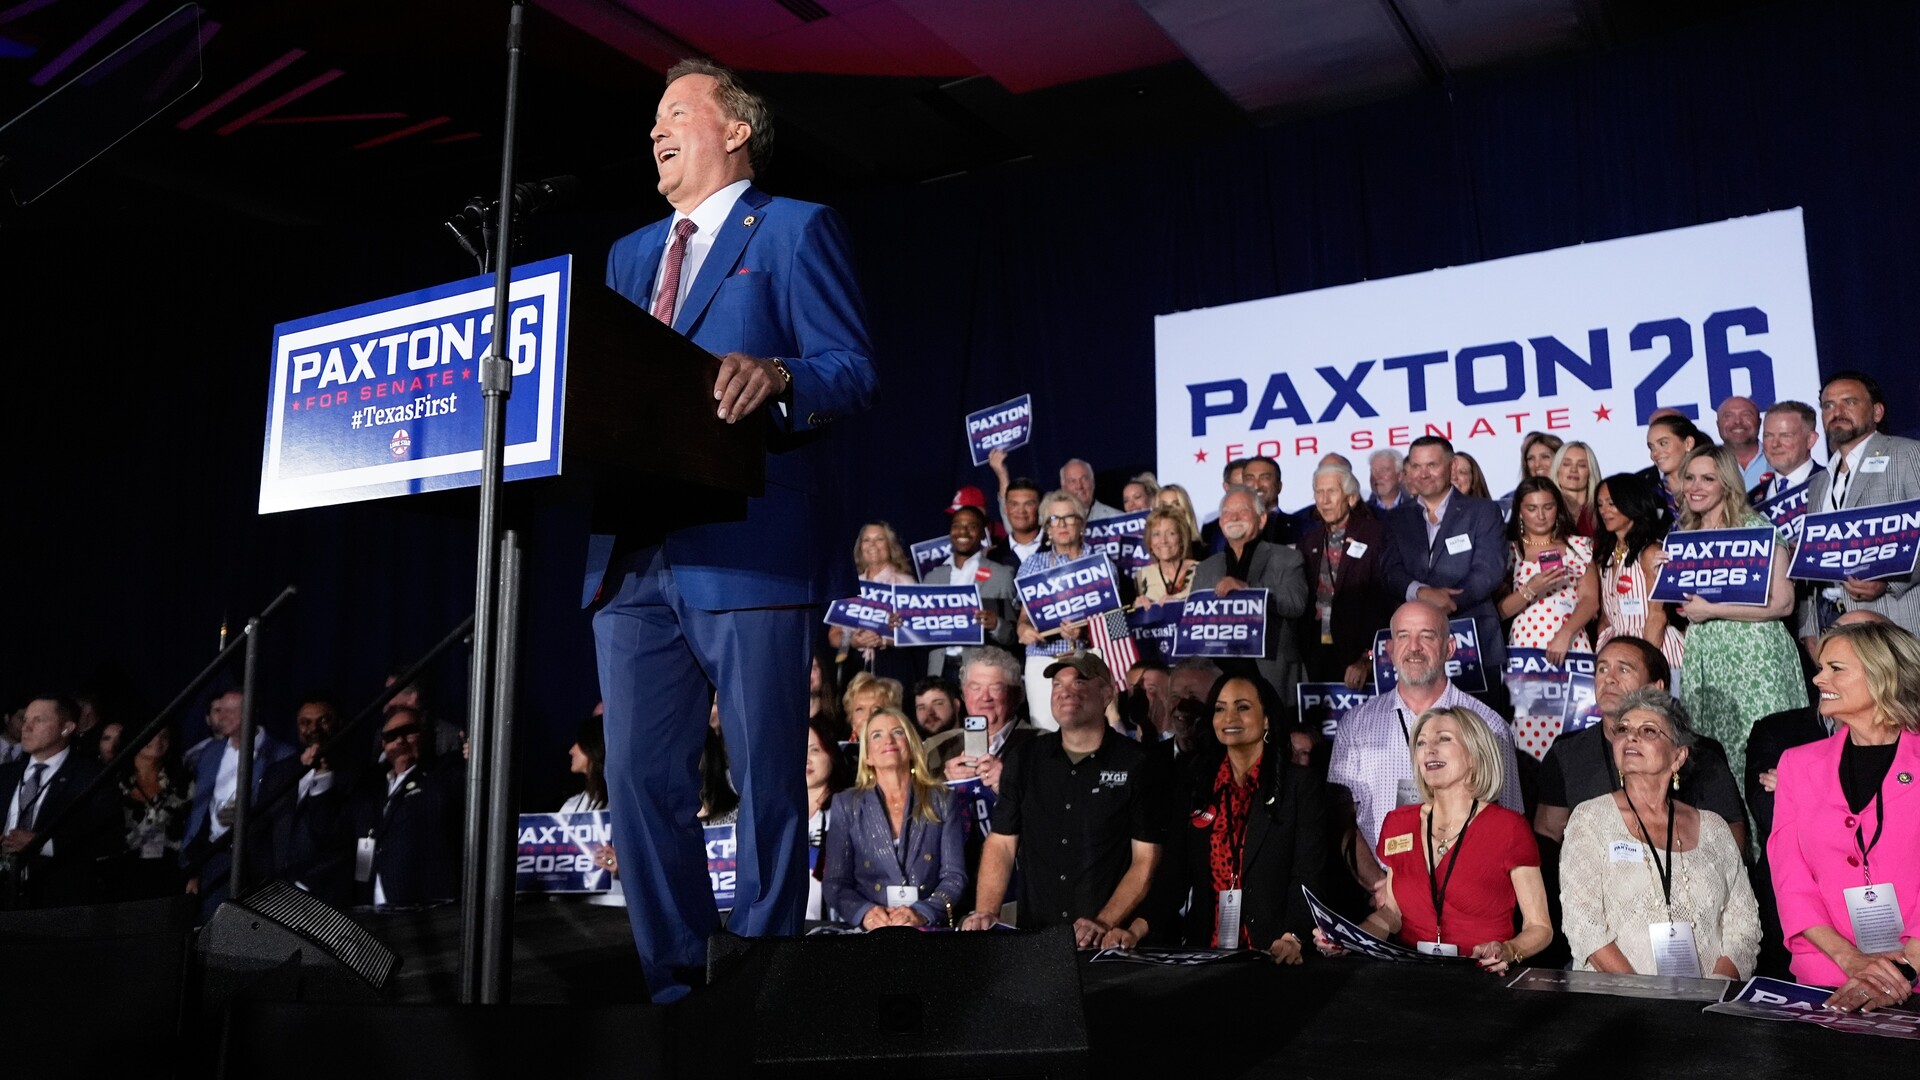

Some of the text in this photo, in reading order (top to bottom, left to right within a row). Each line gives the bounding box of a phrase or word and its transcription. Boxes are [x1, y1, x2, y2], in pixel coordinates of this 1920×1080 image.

[293, 317, 475, 393] PAXTON
[1186, 306, 1776, 437] PAXTON 26
[305, 370, 454, 411] FOR SENATE
[351, 392, 457, 429] #TexasFirst
[969, 403, 1029, 434] PAXTON
[981, 425, 1022, 449] 2026
[1226, 408, 1571, 463] FOR SENATE
[1085, 518, 1147, 538] AXTO
[1805, 511, 1920, 542] PAXTON
[917, 543, 953, 564] PAX
[1668, 540, 1770, 561] PAXTON
[1819, 542, 1899, 568] 2026
[1022, 562, 1109, 602] PAXTON
[1677, 567, 1748, 588] 2026
[895, 592, 978, 609] PAXTON
[1041, 590, 1102, 620] 2026
[1182, 599, 1263, 617] PAXTON
[911, 615, 969, 630] 2026
[1190, 624, 1249, 640] 2026
[1507, 656, 1595, 674] PAXTO
[1304, 693, 1377, 711] PAXT
[518, 823, 612, 844] AXTON
[516, 854, 594, 873] 2026
